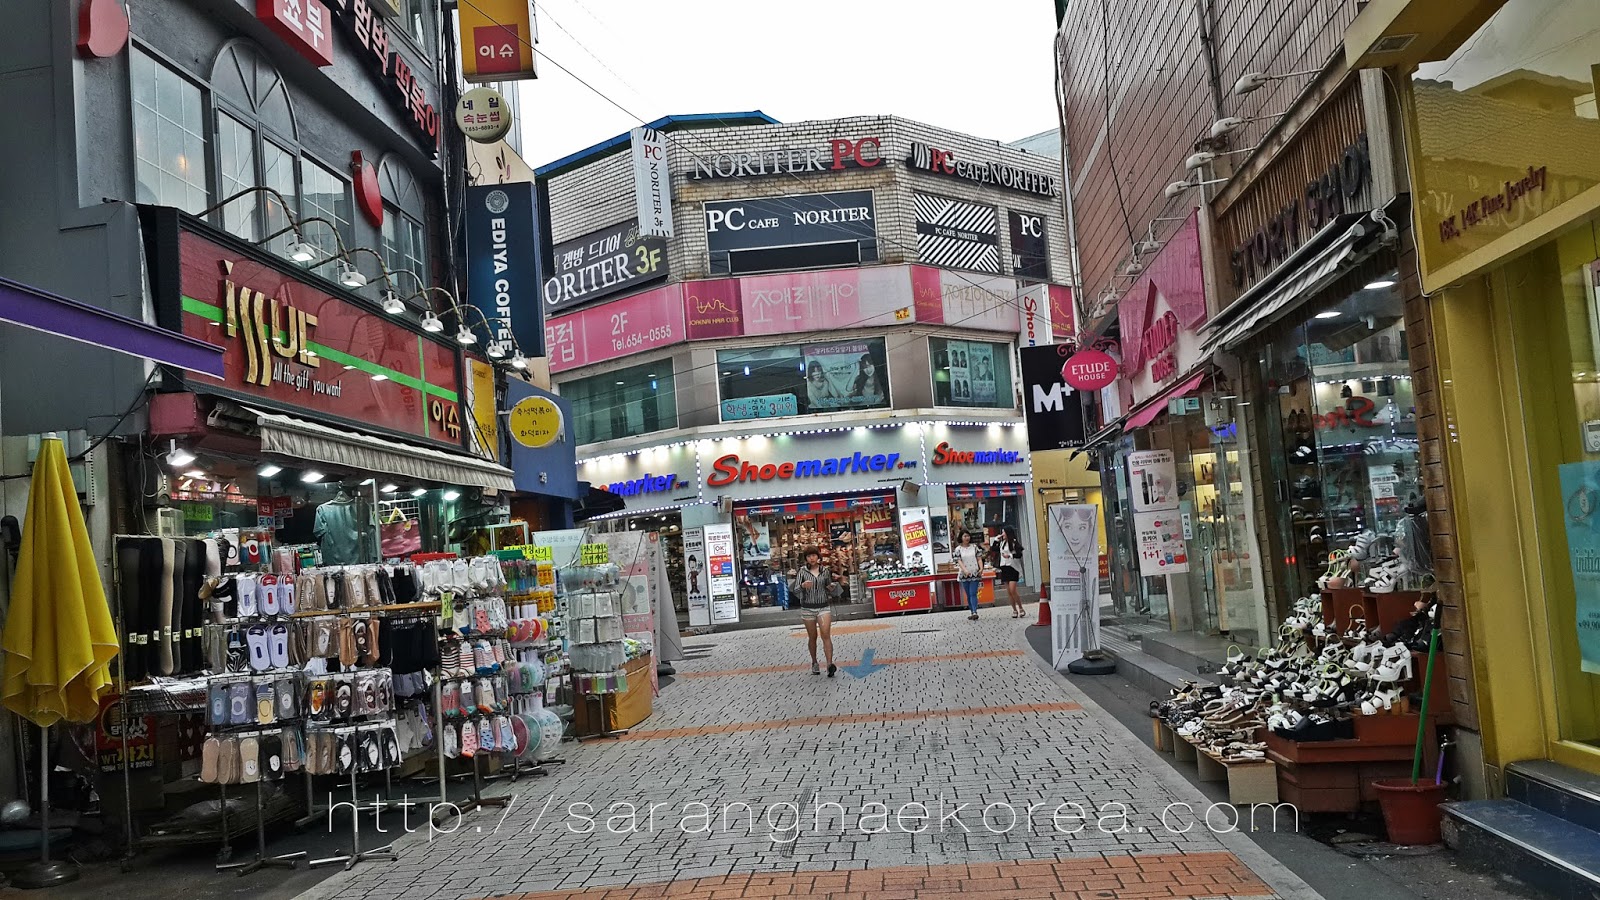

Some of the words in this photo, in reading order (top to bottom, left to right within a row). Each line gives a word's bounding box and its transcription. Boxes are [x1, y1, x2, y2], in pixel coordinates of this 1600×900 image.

[479, 43, 514, 59] 이슈
[395, 58, 441, 152] 떡볶이
[463, 111, 500, 124] 속눈썹
[643, 144, 663, 161] PC
[692, 149, 827, 180] NORITER
[829, 137, 881, 171] PC
[930, 148, 956, 175] PC
[956, 160, 989, 183] CAFE
[985, 161, 1060, 198] NORITER
[649, 161, 663, 214] NORITER
[1504, 165, 1547, 212] Jewelry
[653, 216, 664, 228] 3F
[706, 207, 747, 233] PC
[748, 217, 779, 230] CAFE
[792, 206, 872, 226] NORITER
[1020, 214, 1042, 238] PC
[491, 217, 508, 274] EDIYA
[934, 227, 943, 235] PC
[943, 228, 956, 238] CAFE
[957, 230, 979, 241] NORITER
[562, 246, 584, 270] 겜방
[588, 232, 622, 261] 드디어
[635, 245, 662, 274] 3F
[494, 278, 513, 351] COFFEE
[611, 312, 629, 336] 2F
[612, 324, 672, 351] Tel.654-0555
[272, 362, 282, 380] All
[282, 366, 295, 385] the
[295, 369, 310, 393] gift
[312, 380, 325, 396] you
[325, 379, 342, 398] want
[1071, 361, 1111, 375] ETUDE
[1078, 373, 1106, 381] HOUSE
[431, 399, 462, 439] 이슈
[517, 406, 552, 416] 즉석떡볶이
[726, 402, 747, 417] 학생
[769, 401, 793, 416] 3만원
[932, 441, 1018, 465] Shoemarker
[706, 452, 900, 487] Shoemarker
[864, 509, 892, 525] SALE
[905, 529, 927, 541] CLICK!
